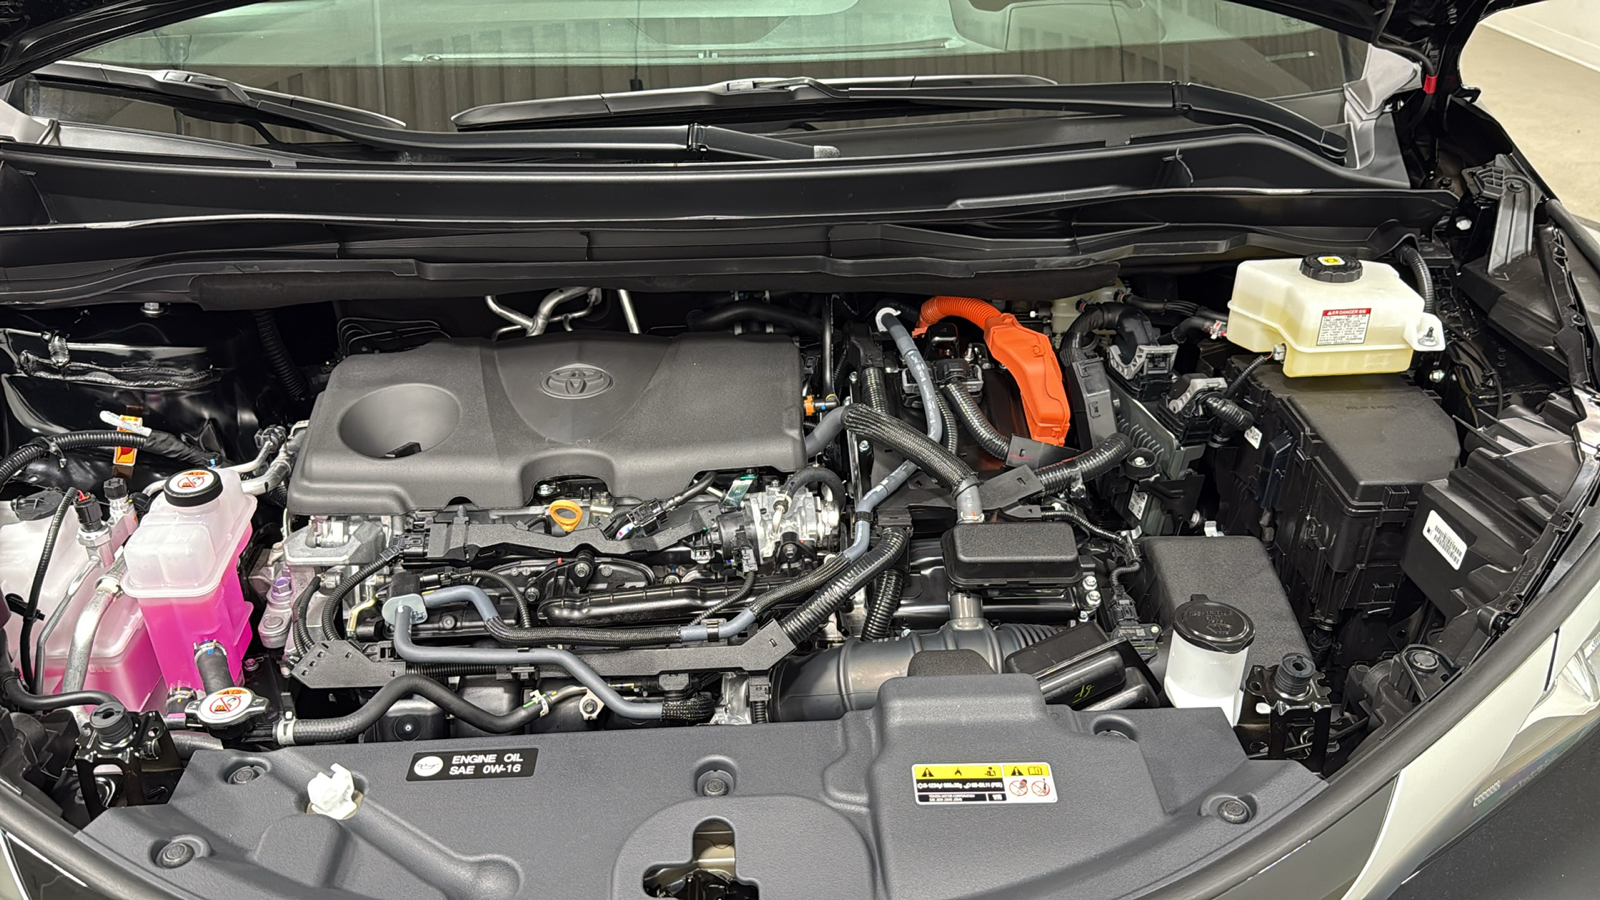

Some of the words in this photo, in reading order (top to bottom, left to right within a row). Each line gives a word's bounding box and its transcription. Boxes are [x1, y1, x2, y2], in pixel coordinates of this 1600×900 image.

[451, 754, 497, 764] ENGINE
[503, 753, 524, 762] OIL
[449, 765, 475, 775] SAE
[482, 764, 521, 774] 0W-16
